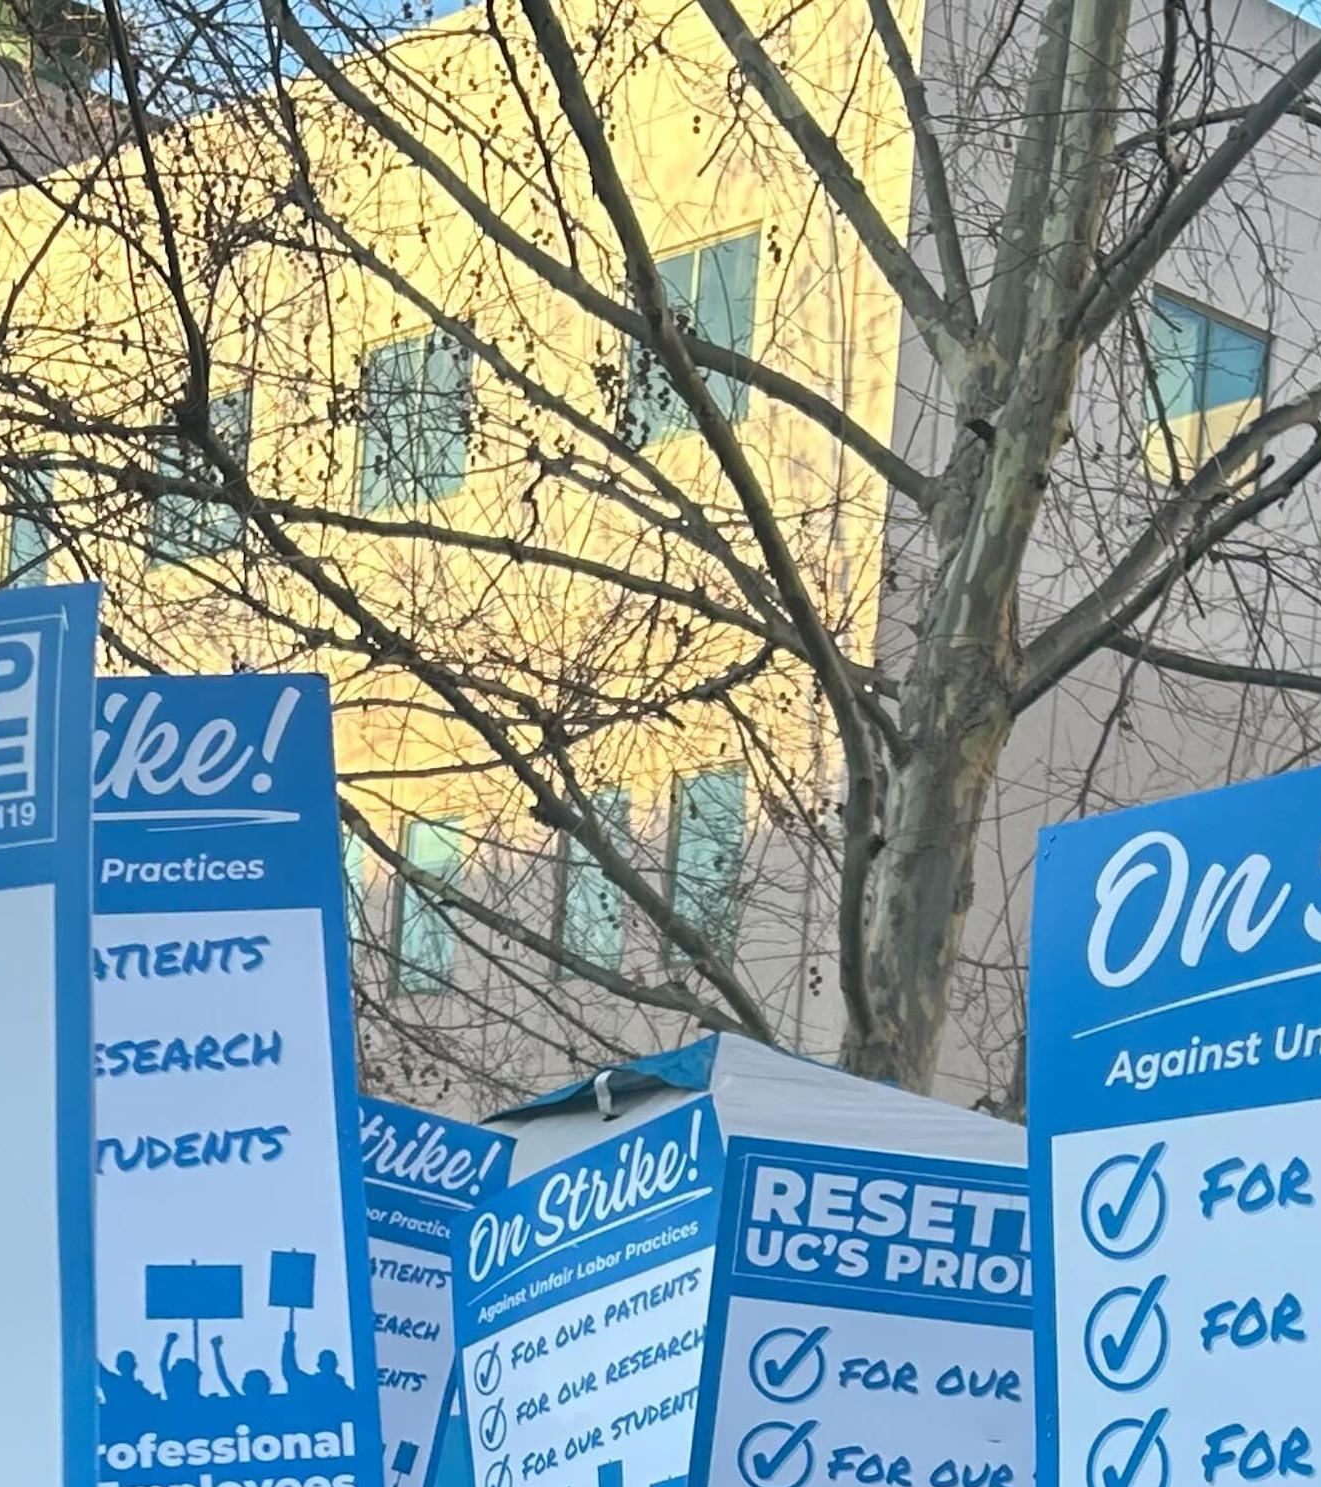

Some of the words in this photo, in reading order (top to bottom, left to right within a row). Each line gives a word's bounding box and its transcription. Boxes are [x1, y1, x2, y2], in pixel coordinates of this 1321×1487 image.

[93, 686, 302, 799] ike!
[101, 853, 265, 883] Practices
[1087, 831, 1290, 989] On
[1104, 1033, 1262, 1091] Against
[96, 1125, 290, 1175] TUDENTS
[469, 1212, 531, 1281] On
[535, 1109, 702, 1247] Strike!
[1199, 1160, 1314, 1219] FOR
[388, 1210, 451, 1239] Practic
[745, 1228, 869, 1278] UC'S
[479, 1287, 527, 1324] Against
[529, 1267, 574, 1298] Unfair
[576, 1252, 621, 1280] Labor
[625, 1221, 699, 1260] Practices
[375, 1313, 440, 1342] EARCH
[511, 1335, 548, 1369] FOR
[556, 1314, 597, 1347] OUR
[604, 1268, 701, 1326] PATIENTS
[1199, 1293, 1306, 1353] FOR
[378, 1368, 427, 1392] ENTS
[517, 1392, 550, 1424] FOR
[558, 1373, 598, 1405] OUR
[606, 1323, 707, 1384] RESEARCH
[839, 1358, 918, 1394] FOR
[936, 1364, 1022, 1401] OUR
[522, 1448, 558, 1481] FOR
[565, 1427, 604, 1459] OUR
[610, 1385, 699, 1440] STUDENT
[1201, 1425, 1314, 1485] FOR
[827, 1445, 912, 1487] FOR
